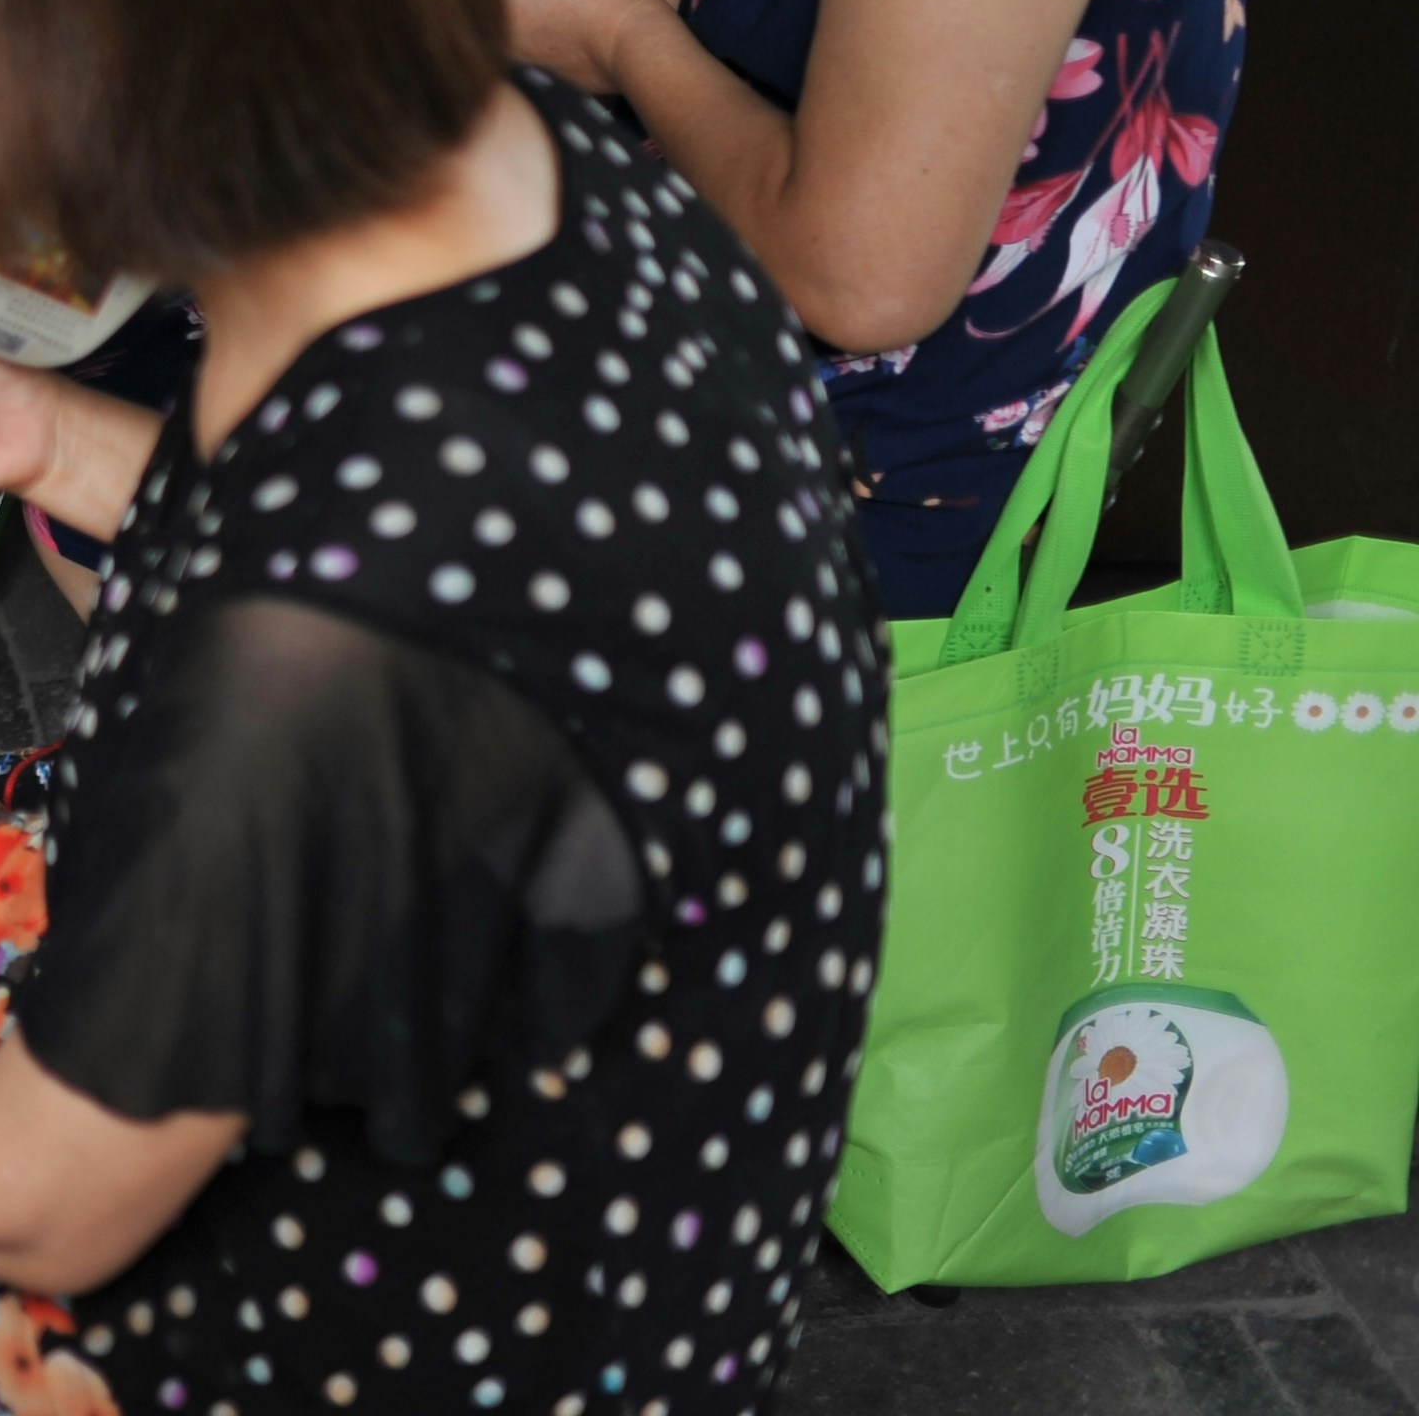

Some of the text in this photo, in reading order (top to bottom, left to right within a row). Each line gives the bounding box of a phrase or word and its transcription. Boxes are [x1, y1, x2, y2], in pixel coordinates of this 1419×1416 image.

[1081, 766, 1211, 828] 壹选
[1139, 820, 1194, 982] 洗衣凝珠
